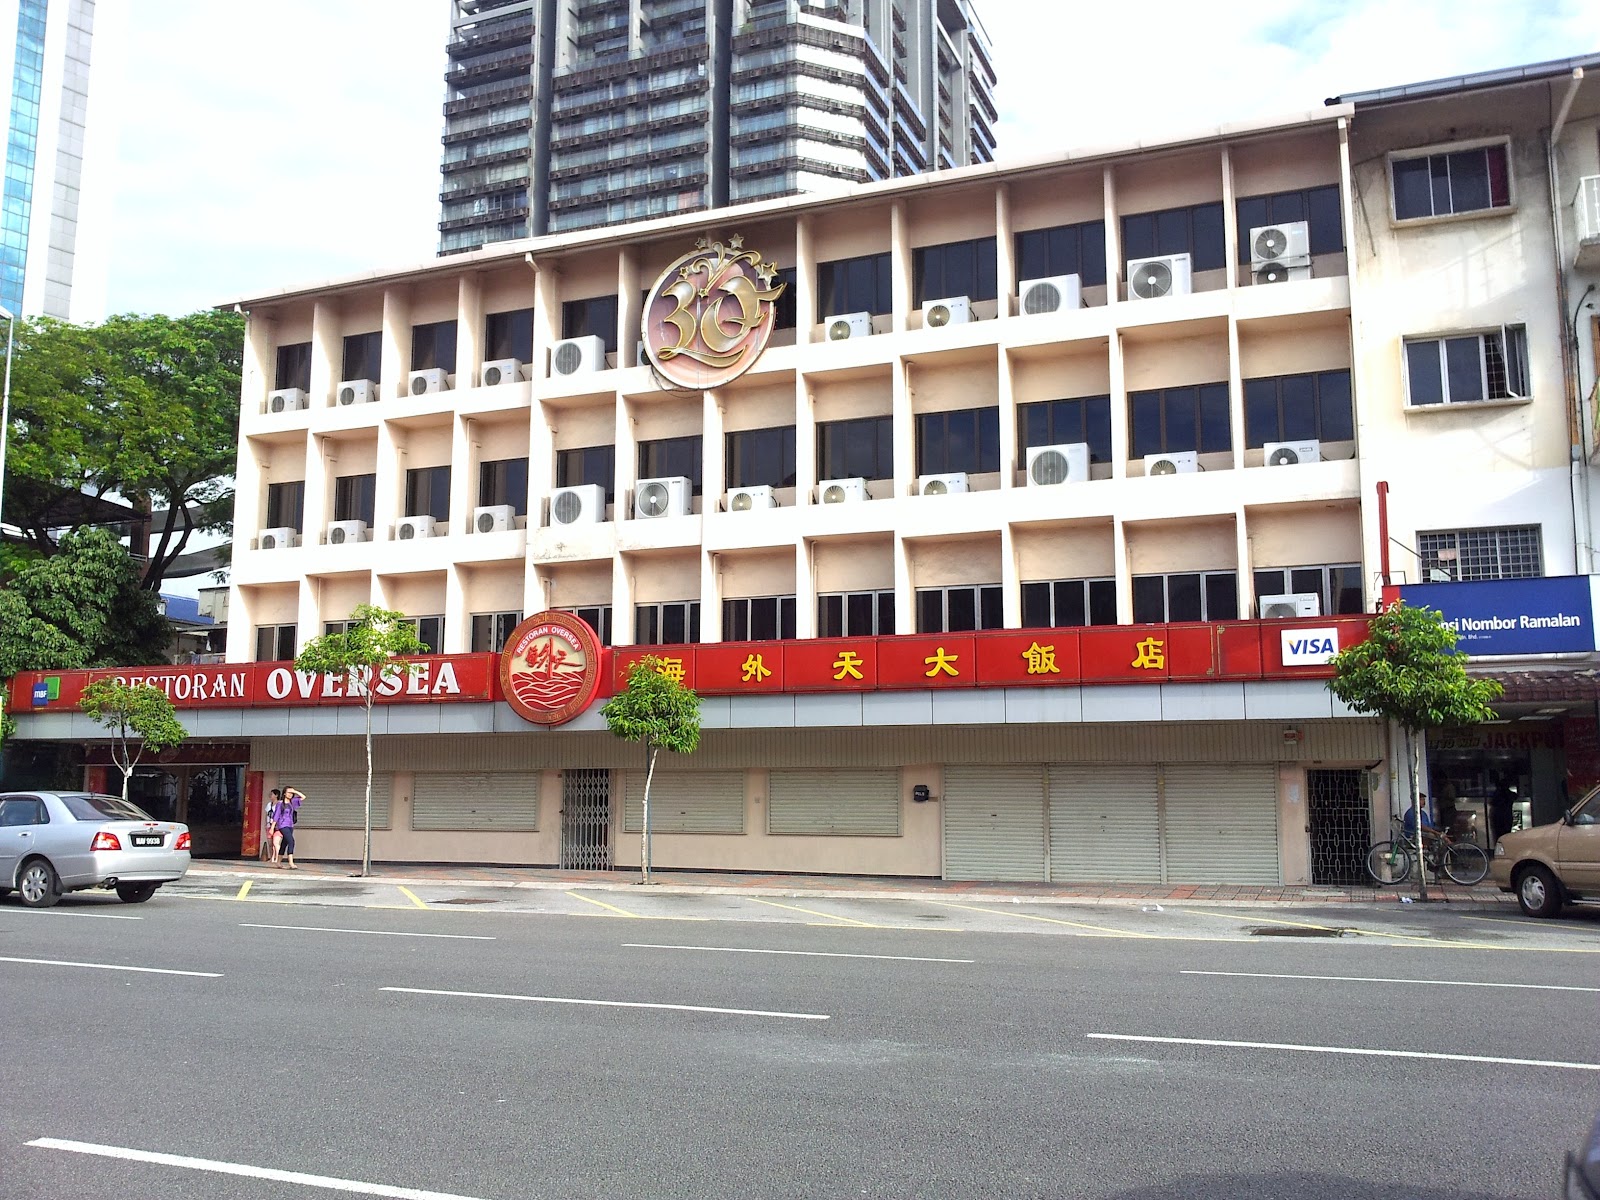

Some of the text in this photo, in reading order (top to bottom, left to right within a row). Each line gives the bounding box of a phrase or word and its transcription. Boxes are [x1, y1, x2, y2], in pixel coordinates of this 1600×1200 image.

[1461, 615, 1517, 631] Nombor
[1519, 613, 1581, 630] Ramalan
[516, 626, 580, 654] RESTORAN OVERSEA
[1288, 638, 1335, 656] VISA
[266, 662, 461, 700] OVERSEA
